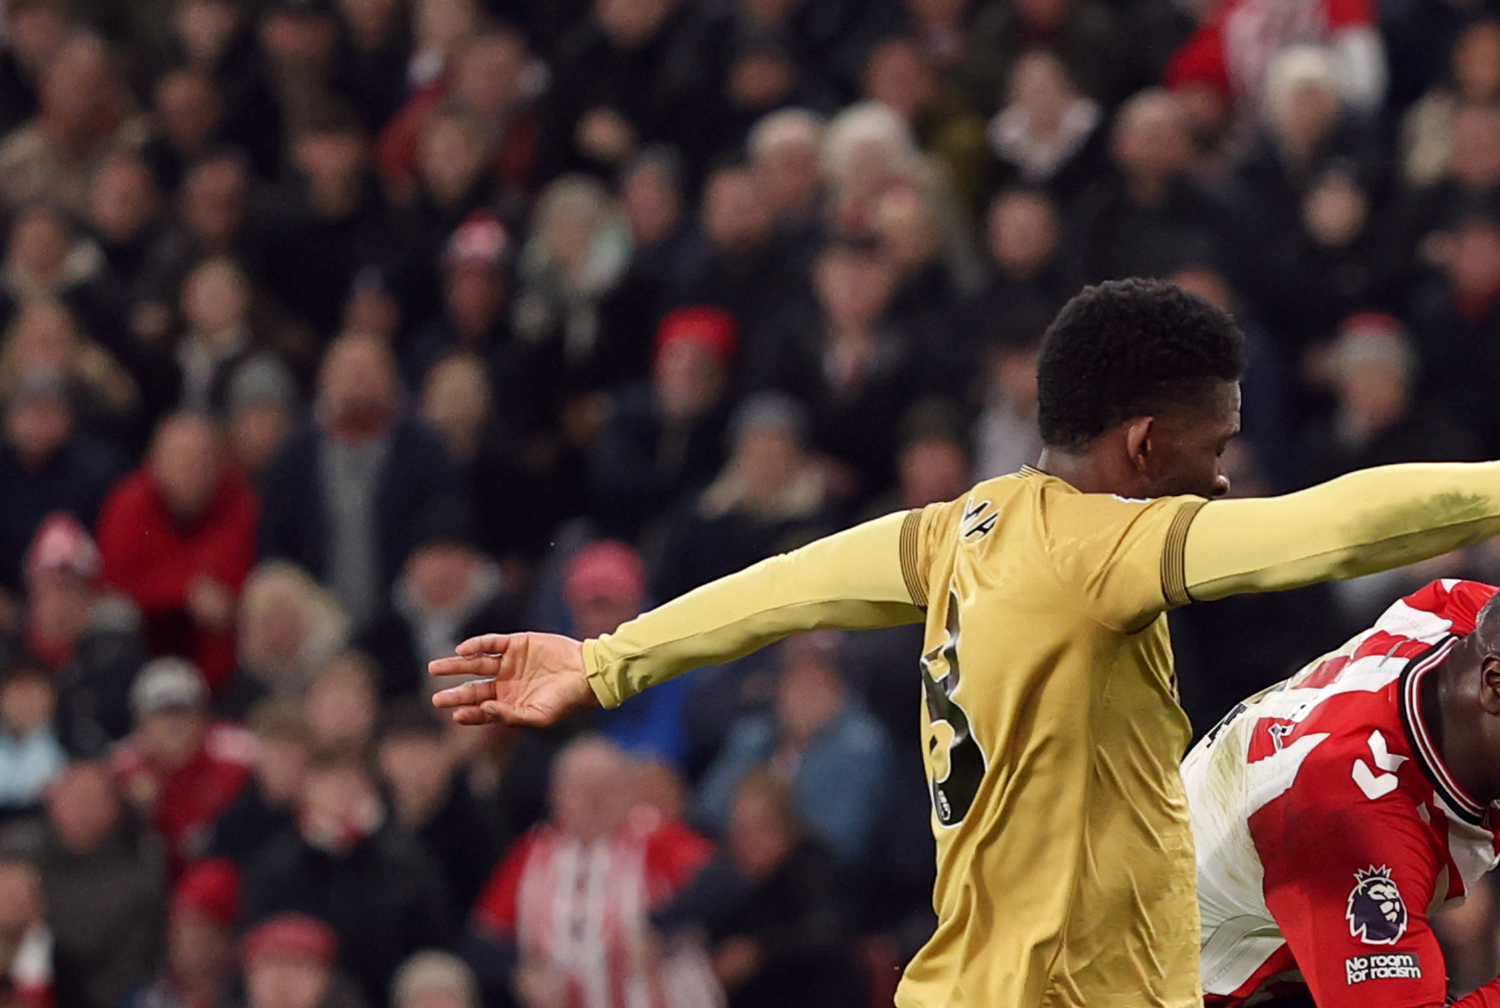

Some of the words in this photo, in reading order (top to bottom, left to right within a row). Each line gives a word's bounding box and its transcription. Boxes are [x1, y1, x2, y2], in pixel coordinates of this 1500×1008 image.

[1345, 957, 1368, 973] No
[1370, 954, 1413, 968] room
[1347, 970, 1369, 985] for
[1370, 966, 1421, 979] racism
